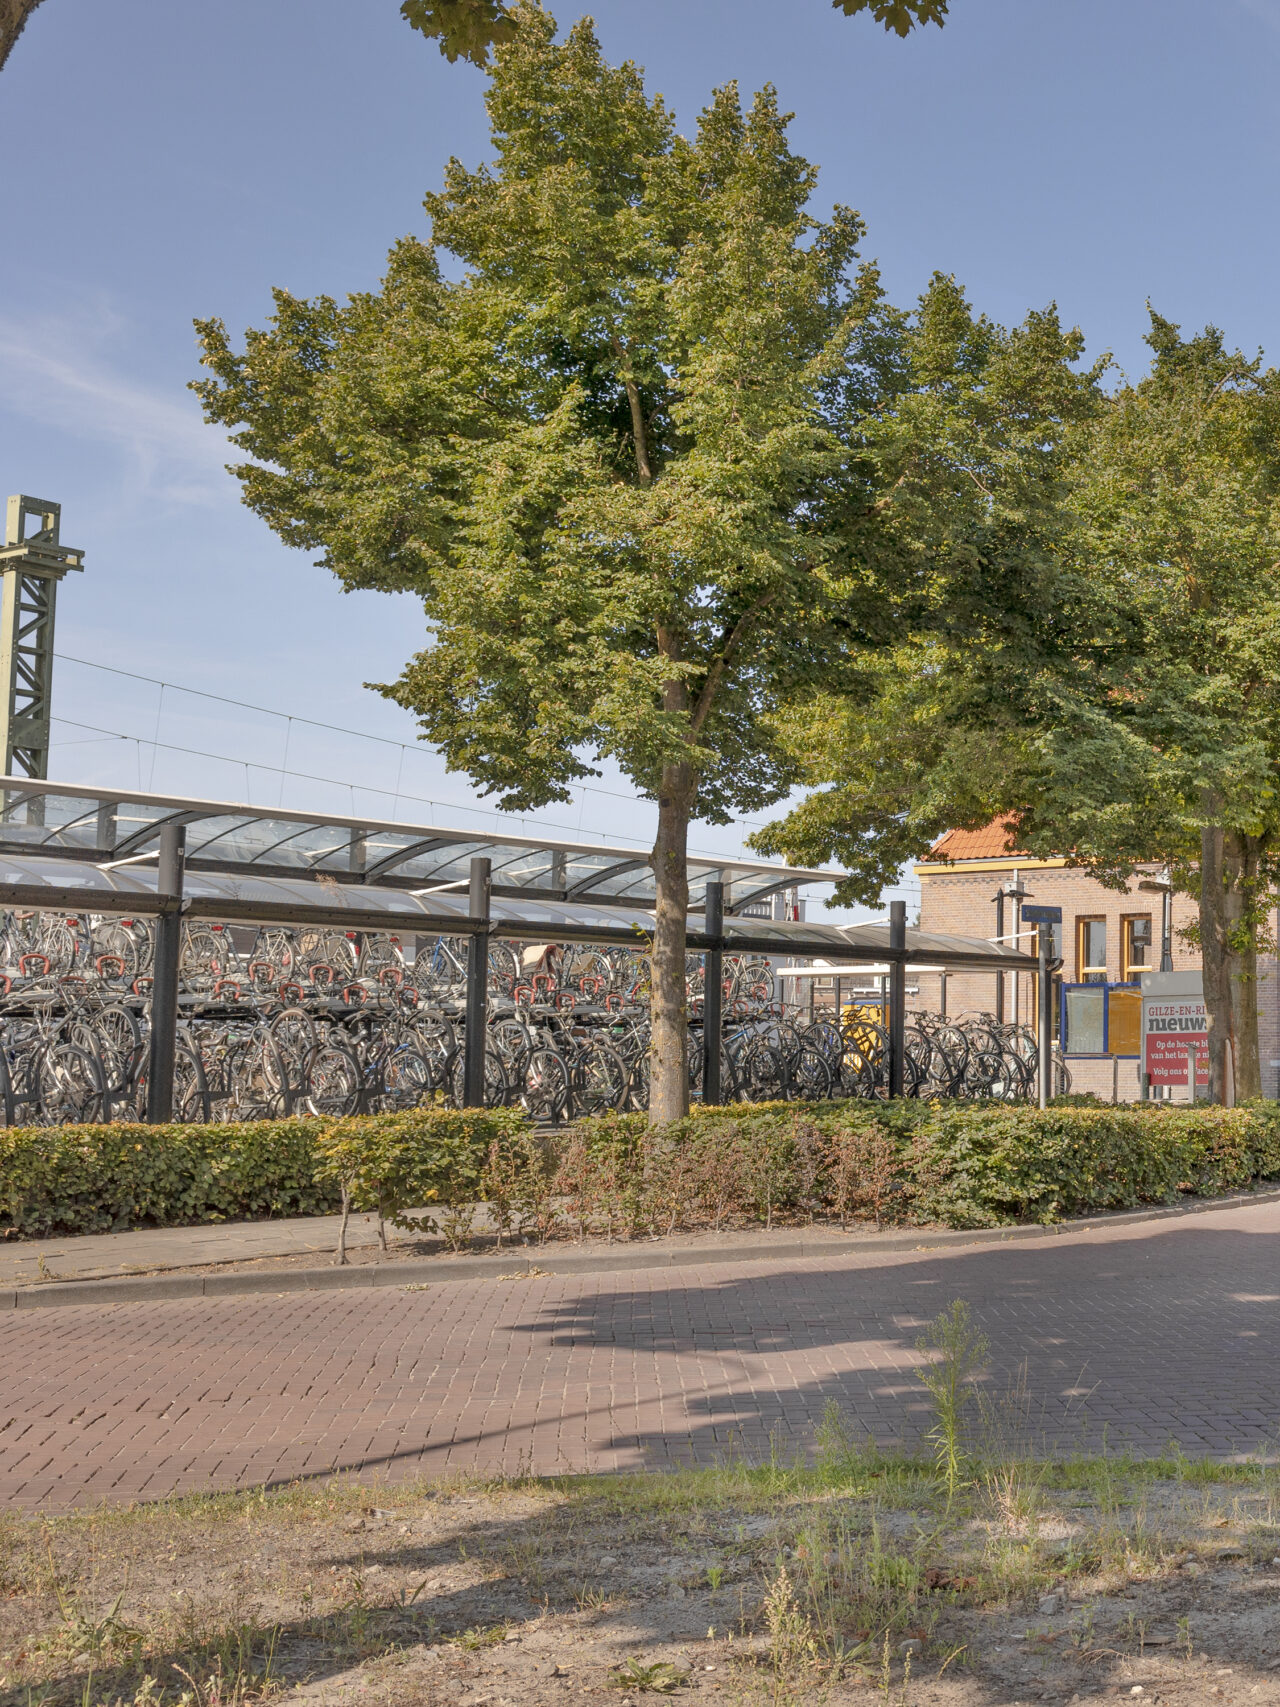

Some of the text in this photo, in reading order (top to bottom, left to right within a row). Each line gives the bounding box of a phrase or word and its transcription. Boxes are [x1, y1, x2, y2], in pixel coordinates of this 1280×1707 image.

[1149, 1006, 1205, 1016] GILZE-EN-RI
[1156, 1041, 1165, 1049] Op
[1167, 1040, 1175, 1048] de
[1165, 1051, 1177, 1059] het
[1153, 1068, 1168, 1077] Volg
